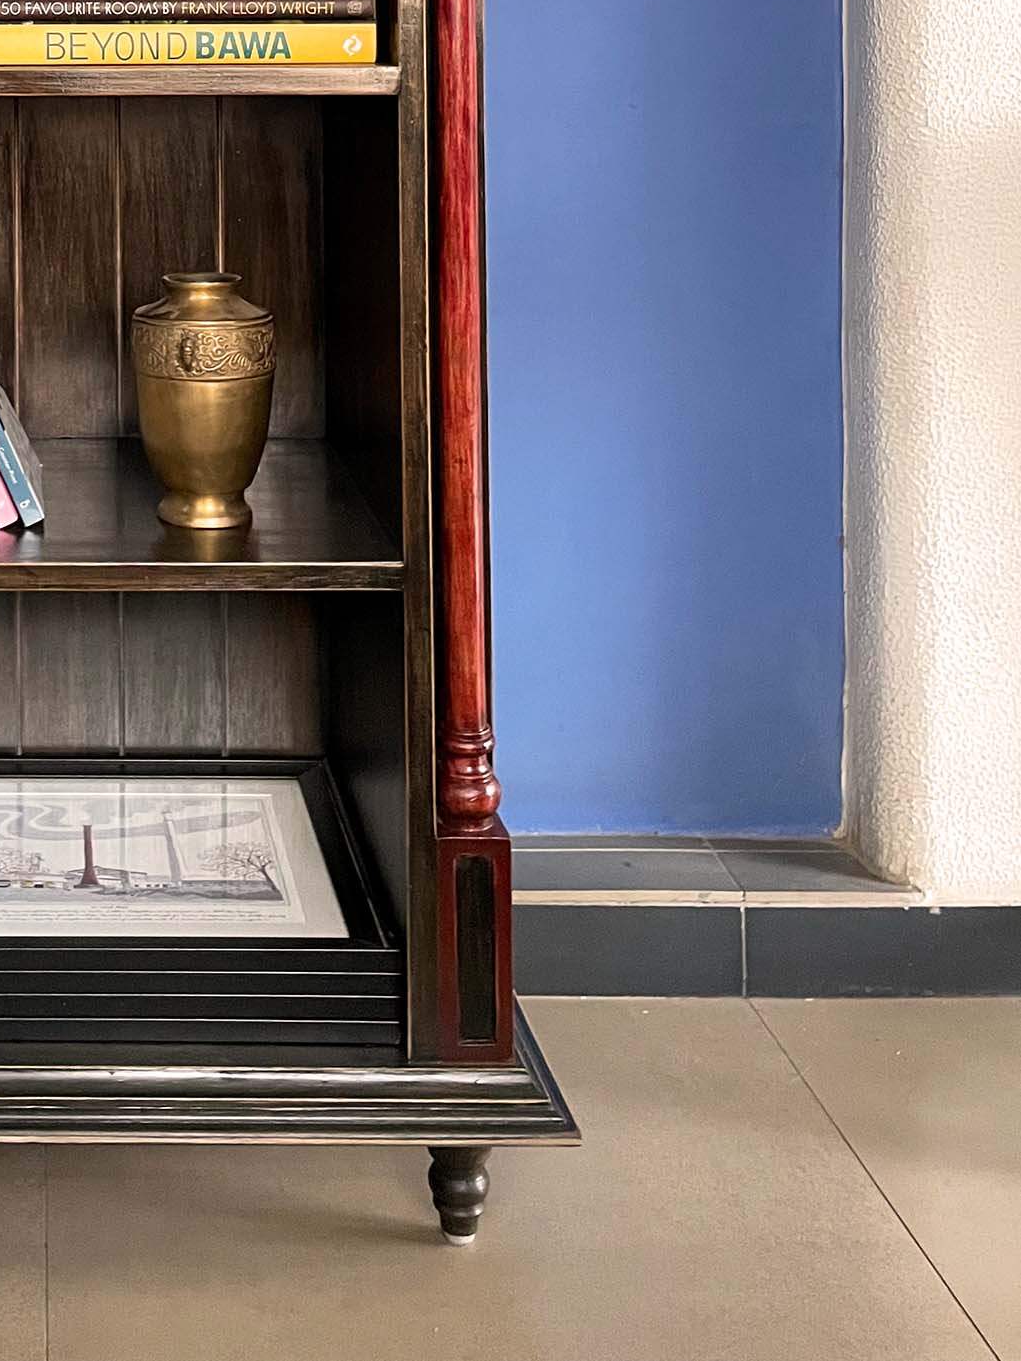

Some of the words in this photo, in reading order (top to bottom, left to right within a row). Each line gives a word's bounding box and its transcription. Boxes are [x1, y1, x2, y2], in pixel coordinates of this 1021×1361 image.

[0, 2, 20, 15] 50
[25, 2, 103, 15] FAVOURITE
[105, 2, 158, 15] ROOMS
[162, 2, 177, 15] BY
[181, 1, 228, 15] FRANK
[232, 1, 276, 15] LLOYD
[280, 1, 336, 15] WRIGHT
[46, 31, 187, 60] BEYOND
[196, 31, 291, 59] BAWA
